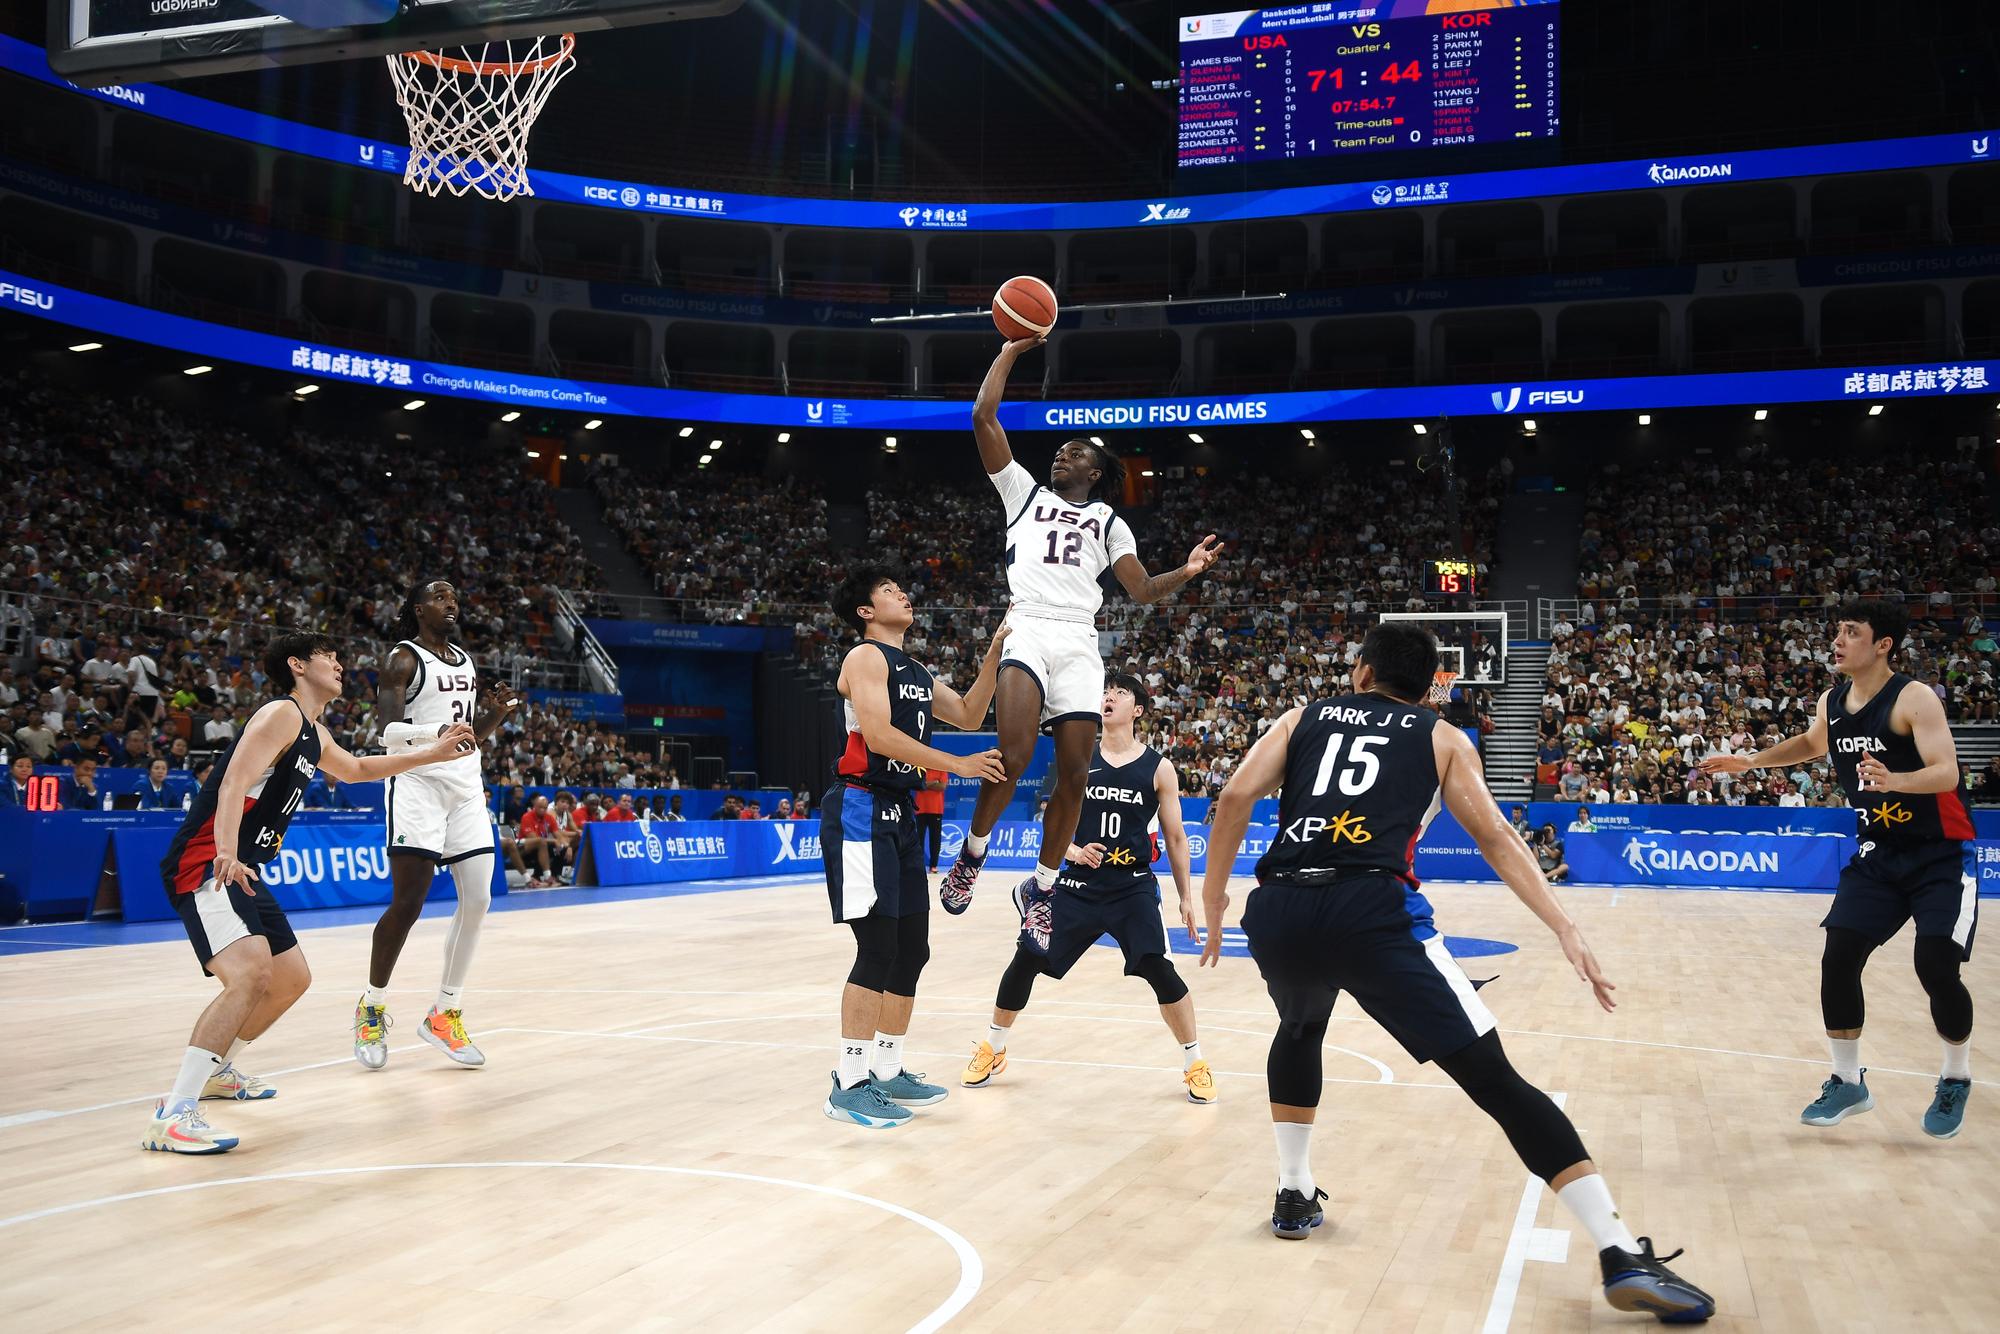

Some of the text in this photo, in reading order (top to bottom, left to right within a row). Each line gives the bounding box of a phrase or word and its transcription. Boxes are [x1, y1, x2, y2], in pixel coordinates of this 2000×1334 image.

[1262, 7, 1307, 18] Basketball
[1262, 20, 1288, 28] Men's
[1289, 13, 1334, 25] Basketball
[1442, 13, 1492, 30] KOR
[1352, 24, 1381, 38] VS
[1444, 31, 1468, 40] SHIN
[1244, 34, 1288, 51] USA
[1337, 42, 1391, 55] Quarter 4
[1444, 41, 1471, 50] PARK
[1444, 50, 1472, 59] YANG
[1475, 49, 1480, 57] J
[1547, 42, 1554, 50] 5
[1190, 57, 1222, 67] JAMES
[1223, 56, 1242, 64] Sion
[1444, 60, 1463, 69] LEE
[1308, 60, 1422, 92] 71 44
[1190, 83, 1227, 94] ELLIOTT
[1190, 92, 1242, 102] HOLLOWAY
[1444, 88, 1472, 97] YANG
[1547, 80, 1554, 88] 3
[1332, 96, 1396, 113] 07:54.7
[1444, 97, 1463, 106] LEE
[1190, 120, 1234, 129] WILLIAMS
[1335, 118, 1393, 130] Time-outs
[1548, 118, 1559, 126] 14
[1190, 129, 1226, 139] WOODS
[1190, 138, 1229, 147] DANIELS
[1308, 130, 1421, 151] 1 Team Foul 0
[1444, 135, 1466, 144] SUN
[1547, 128, 1554, 136] 2
[1190, 156, 1227, 166] FORBES
[1662, 164, 1732, 181] QIAODAN
[1394, 182, 1449, 196] 四川航空
[584, 186, 724, 212] ICBC 中国工商银行
[921, 207, 967, 222] 中国电信
[0, 283, 54, 310] FISU
[291, 347, 607, 404] 成都成就梦想 Chengdu Makes Dreams Come True
[1844, 366, 1989, 394] 成都成就梦想
[1528, 390, 1584, 406] FISU
[1045, 401, 1268, 426] CHENGDU FISU GAMES
[1034, 505, 1101, 541] USA
[1043, 530, 1083, 567] 12
[1441, 575, 1459, 592] 15
[436, 675, 477, 693] USA
[451, 700, 473, 726] 24
[1318, 705, 1417, 728] PARK J C
[1311, 732, 1390, 796] 15
[1085, 786, 1144, 806] KOREA
[1100, 811, 1122, 839] 10
[615, 840, 645, 859] ICBC
[665, 836, 726, 857] 中国工商银行
[1418, 847, 1454, 855] CHENGDU
[1455, 847, 1472, 855] FISU
[329, 846, 390, 882] FISU
[1649, 848, 1779, 874] QIAODAN
[846, 1046, 863, 1055] 23
[878, 1040, 894, 1049] 23
